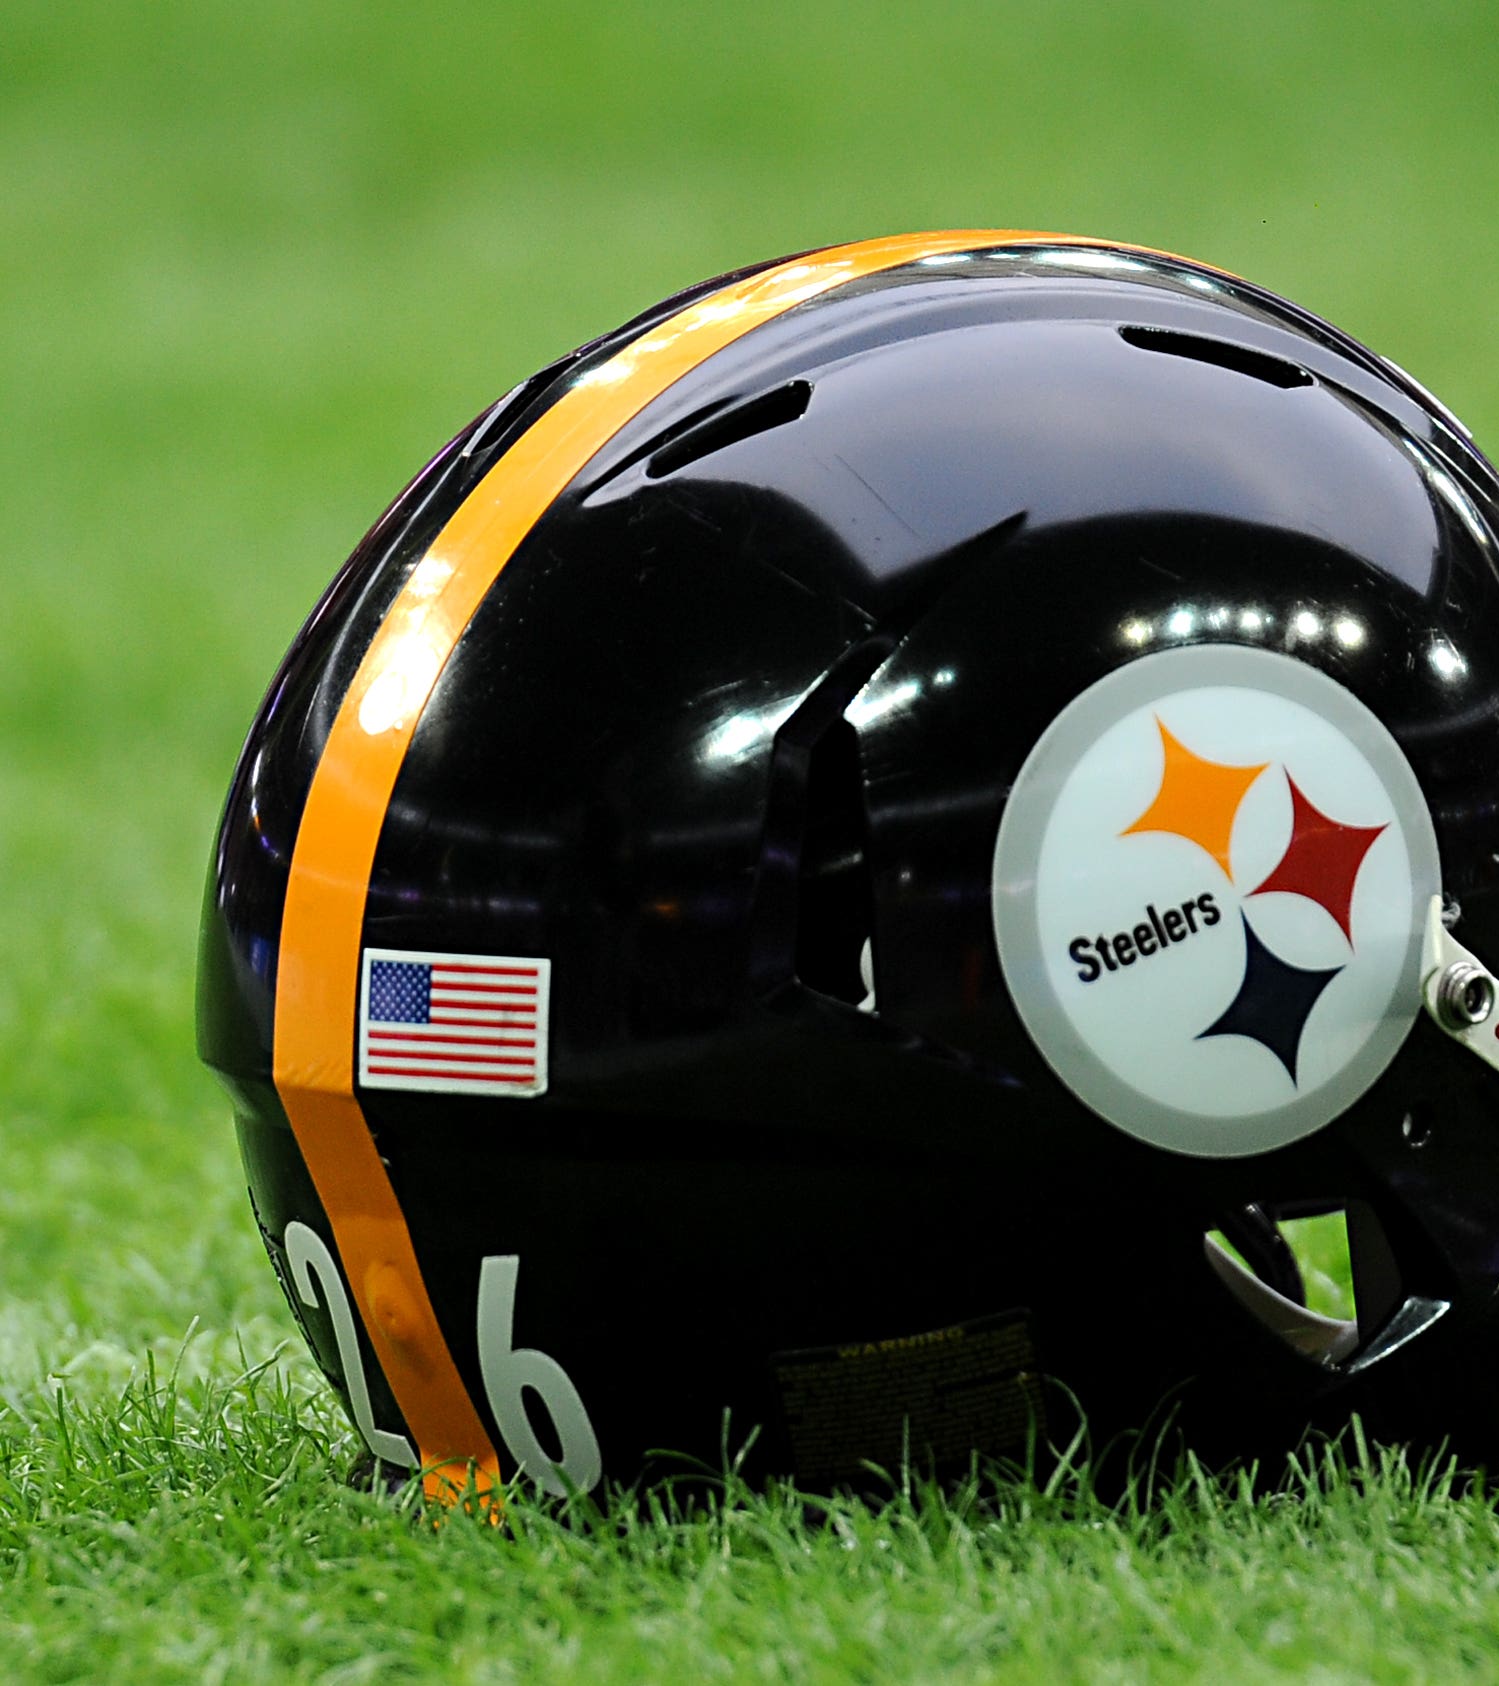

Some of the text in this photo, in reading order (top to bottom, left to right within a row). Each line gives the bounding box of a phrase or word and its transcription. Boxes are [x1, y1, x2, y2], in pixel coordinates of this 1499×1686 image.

[1068, 892, 1221, 983] Steelers
[284, 1221, 421, 1470] 2
[477, 1255, 602, 1499] 6
[837, 1326, 965, 1359] WARNING
